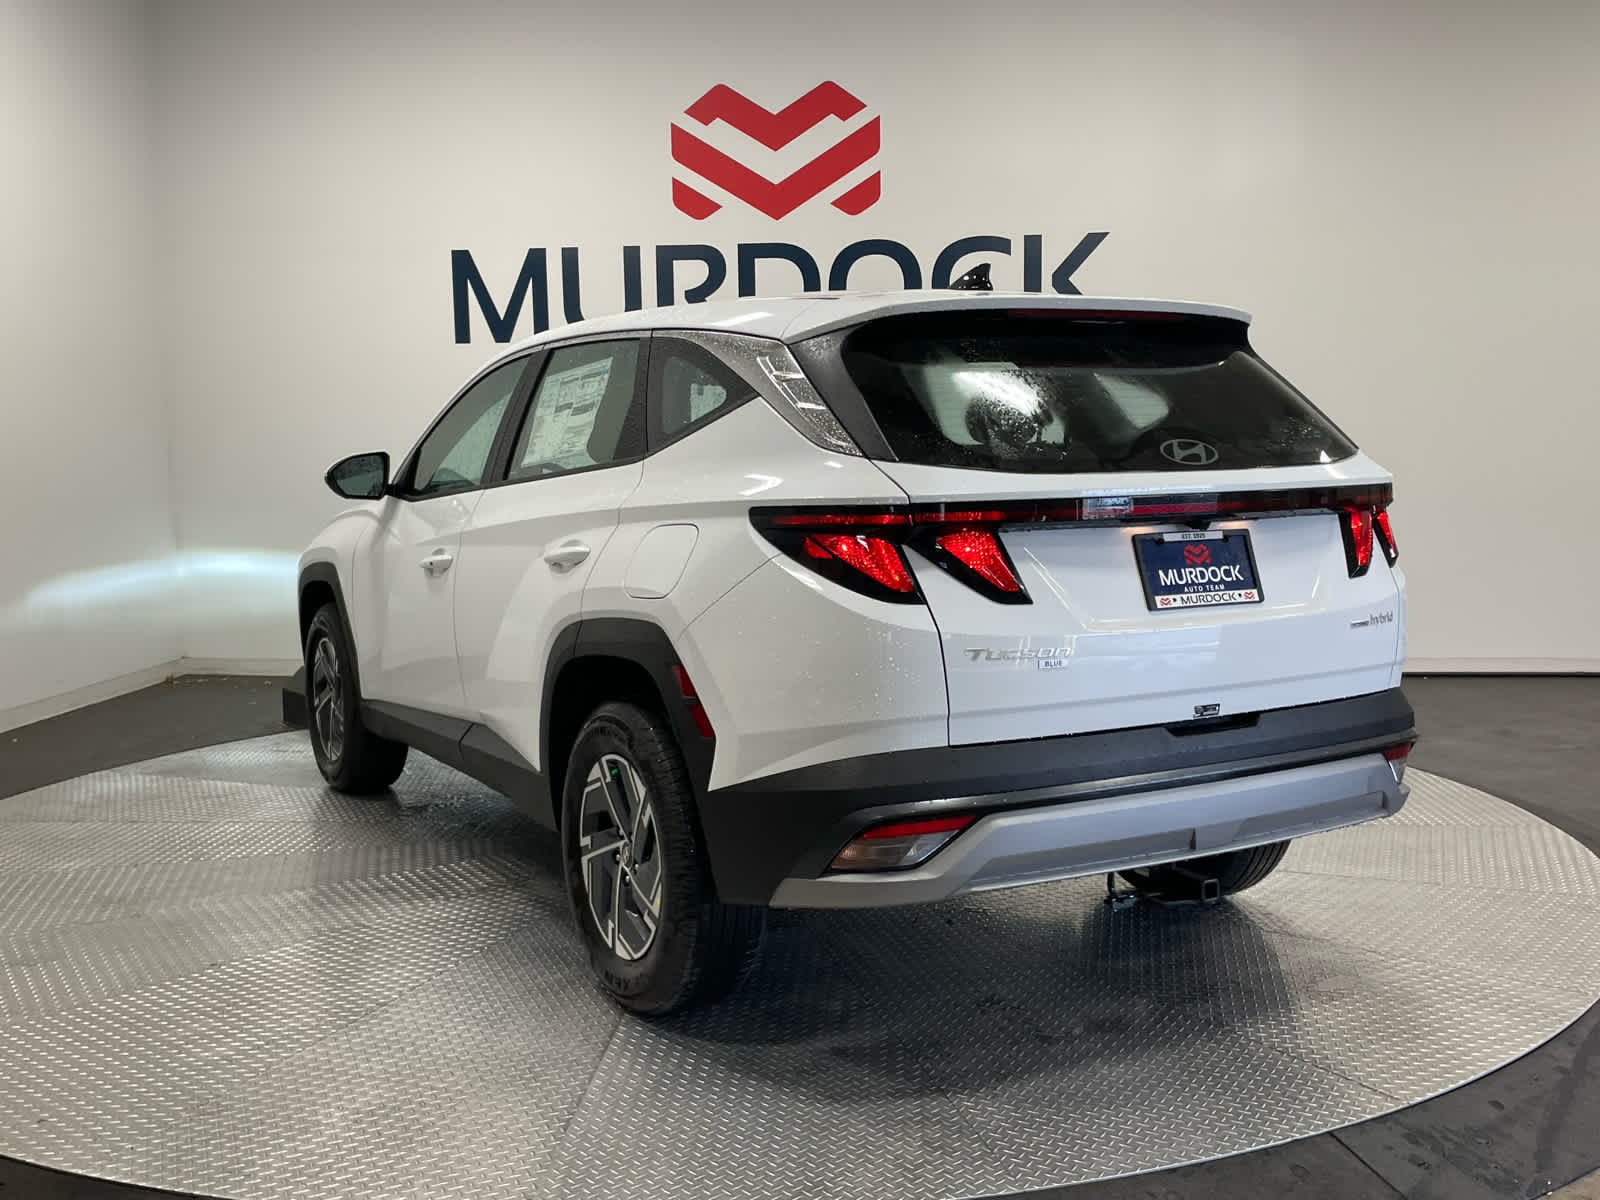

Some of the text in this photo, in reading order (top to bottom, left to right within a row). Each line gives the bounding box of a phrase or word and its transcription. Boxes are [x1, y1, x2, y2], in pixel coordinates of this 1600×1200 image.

[450, 231, 1110, 344] MURDOCK
[1158, 564, 1244, 586] MURDOCK
[1184, 583, 1225, 593] AUTO TEAM
[1180, 591, 1236, 606] MURDOCK
